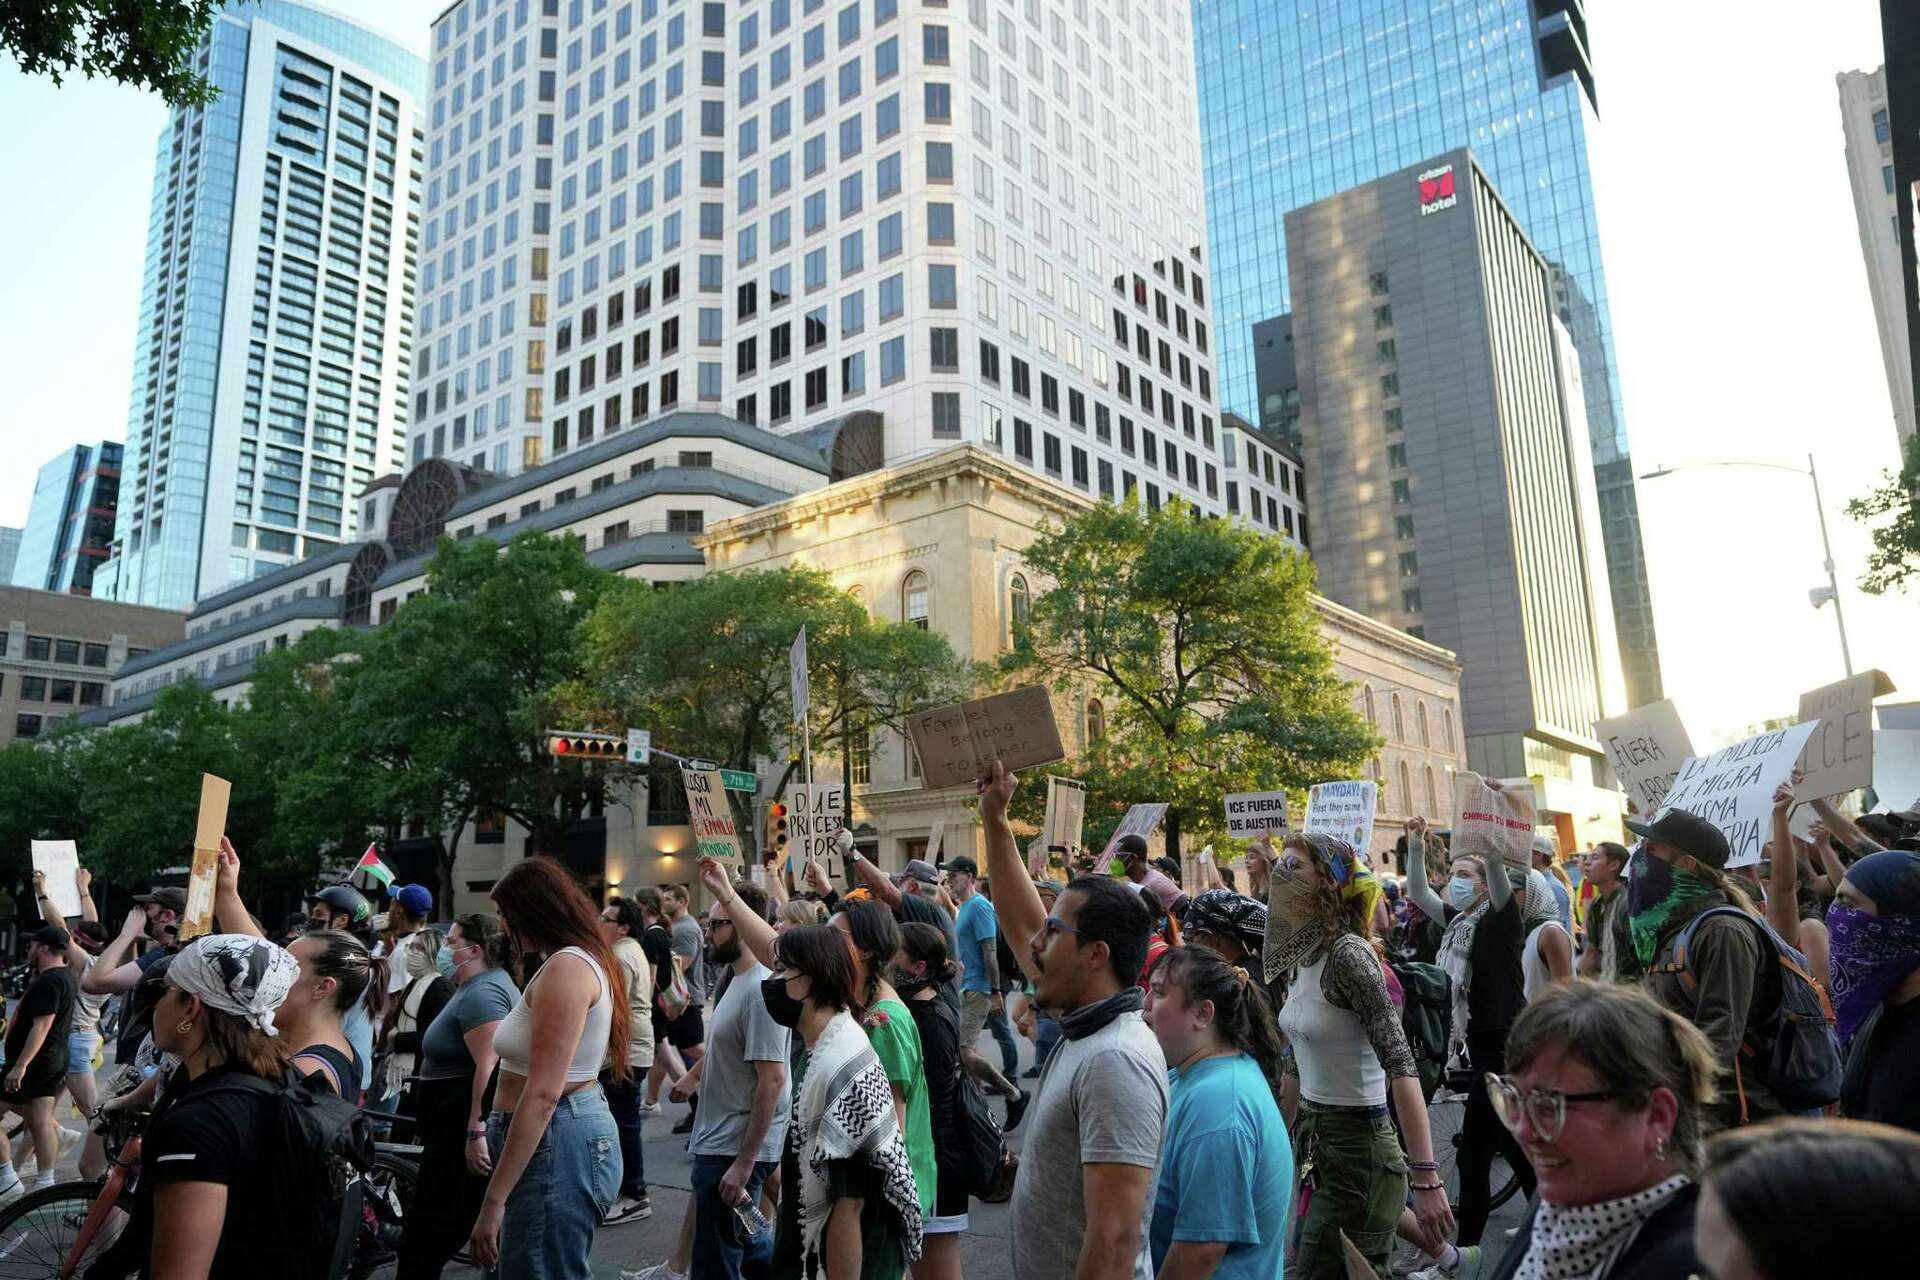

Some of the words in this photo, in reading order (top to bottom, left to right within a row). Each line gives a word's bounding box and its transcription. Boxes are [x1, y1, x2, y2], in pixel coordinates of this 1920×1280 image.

[1421, 193, 1457, 216] hotel
[1609, 736, 1666, 768] FUERA
[729, 774, 744, 786] 7th
[1321, 783, 1360, 798] MAYDAY!
[1693, 762, 1764, 798] MIGRA
[795, 790, 842, 814] DUE
[1229, 801, 1245, 814] ICE
[1248, 798, 1282, 813] FUERA
[1329, 801, 1343, 814] they
[1230, 818, 1243, 830] DE
[1246, 817, 1287, 830] AUSTIN:
[1462, 811, 1494, 822] CHINGA
[1506, 819, 1531, 832] MURO
[804, 836, 839, 857] FOR
